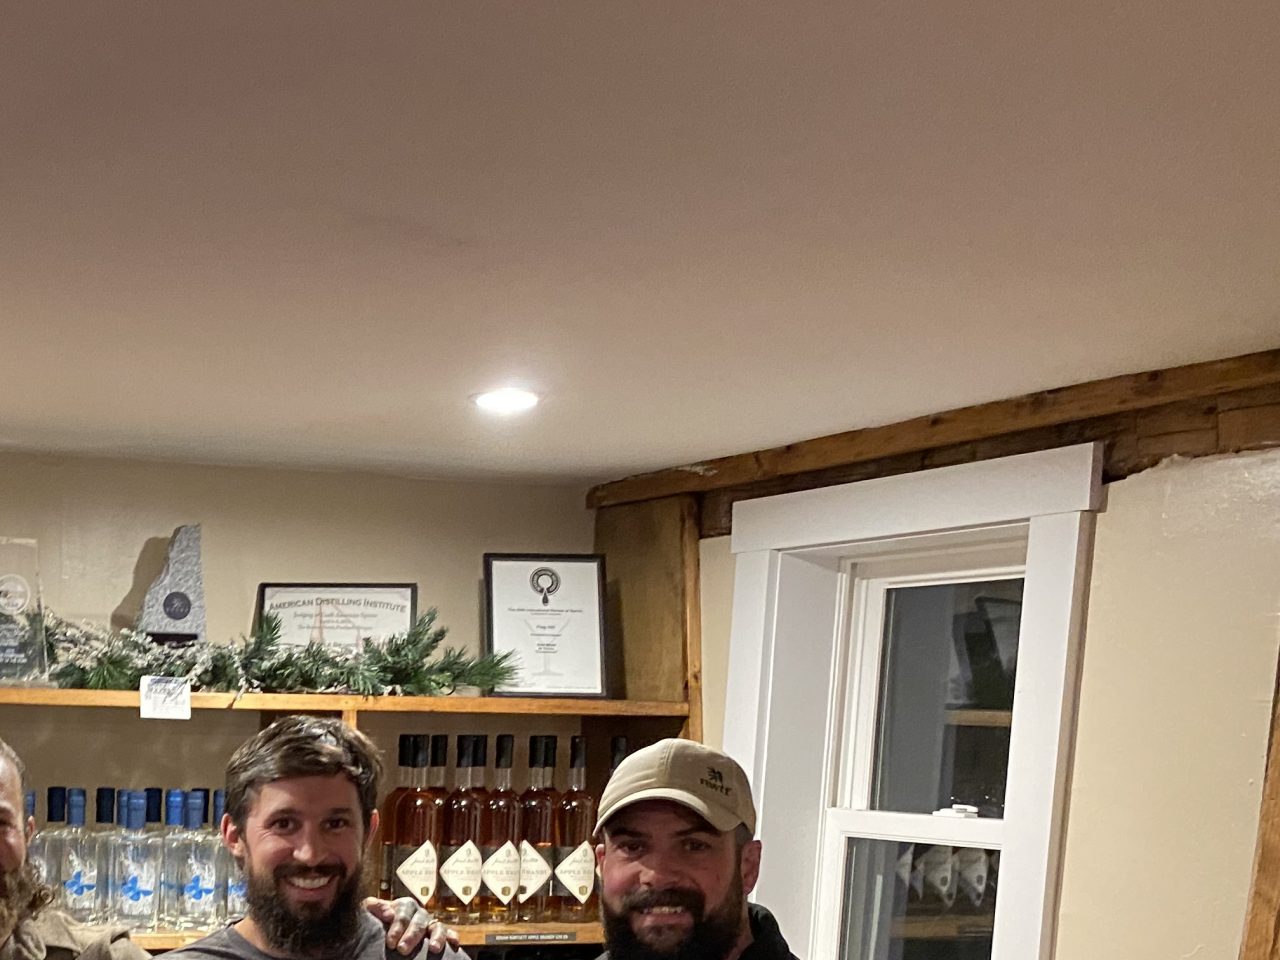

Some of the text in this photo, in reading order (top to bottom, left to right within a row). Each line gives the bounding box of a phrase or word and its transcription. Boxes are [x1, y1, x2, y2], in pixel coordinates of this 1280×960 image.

[270, 597, 408, 613] AMERICAN DISTILLING INSTITUTE
